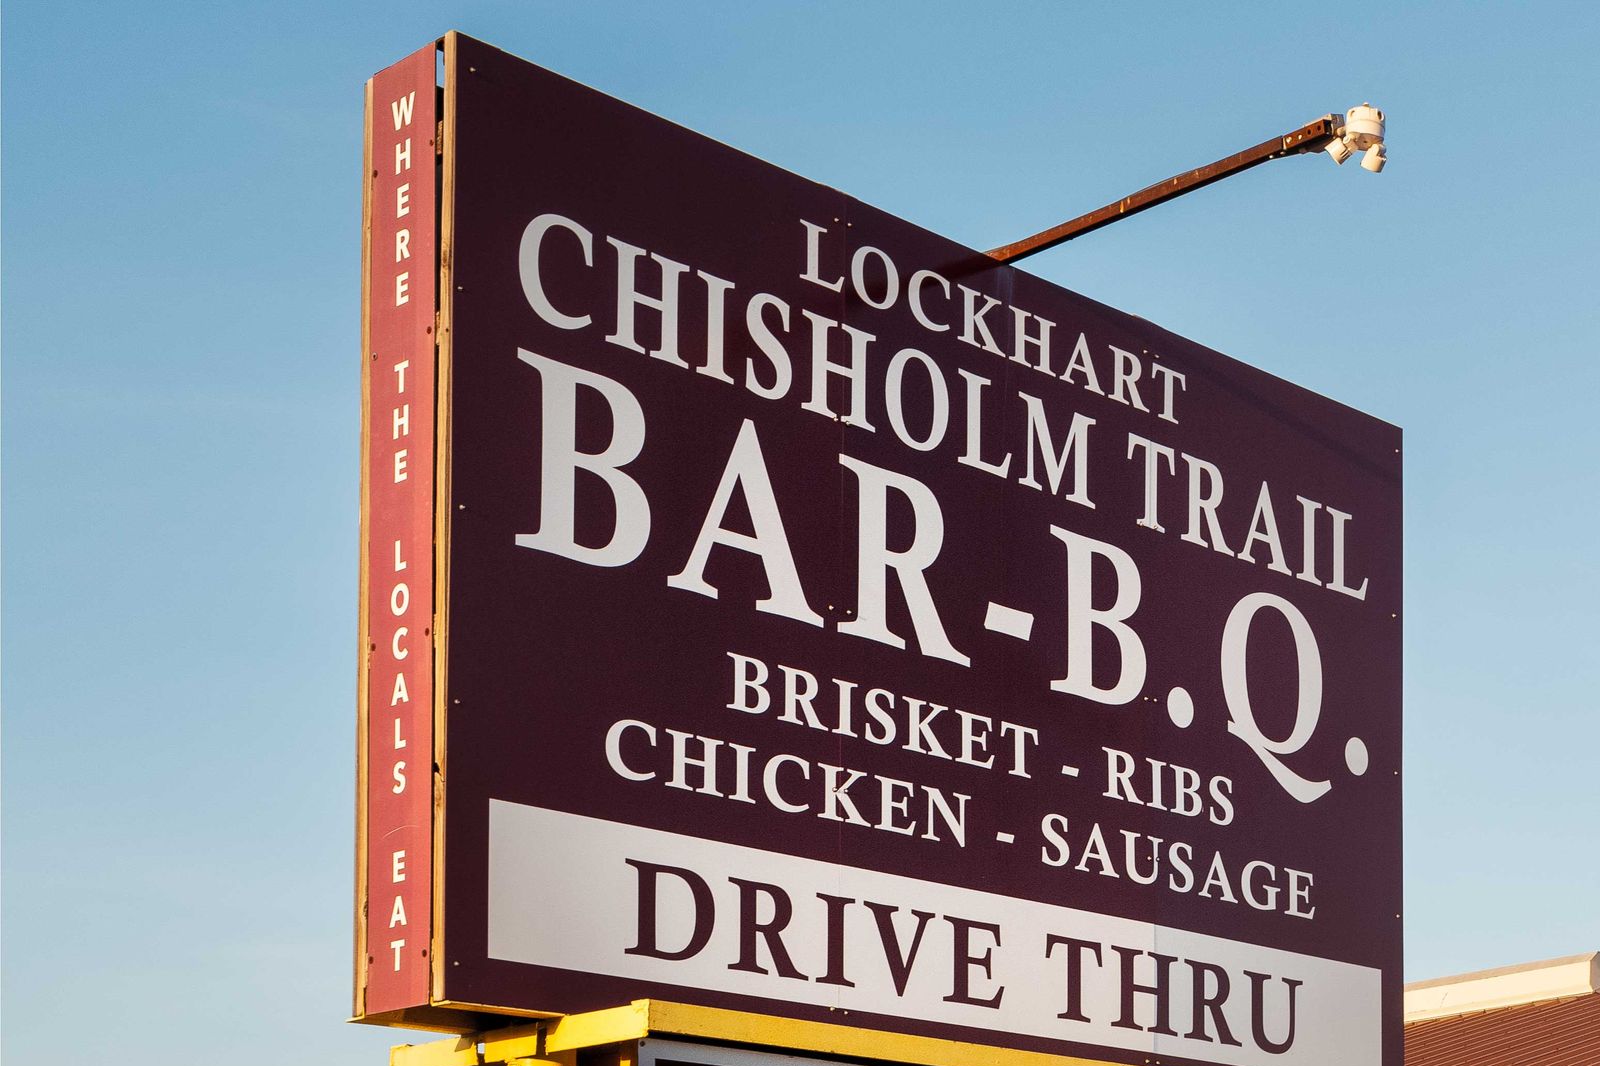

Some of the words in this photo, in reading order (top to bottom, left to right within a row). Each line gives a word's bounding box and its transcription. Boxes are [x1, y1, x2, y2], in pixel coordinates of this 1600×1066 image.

[391, 91, 416, 307] WHERE
[392, 360, 410, 484] THE
[519, 213, 1097, 510] CHISHOLM
[1128, 432, 1369, 601] TRAIL
[800, 219, 1187, 425] LOCKHART
[390, 539, 410, 795] LOCALS
[727, 652, 1039, 779] BRISKET
[1102, 747, 1235, 826] RIBS
[388, 850, 409, 972] EAT
[606, 719, 972, 848] CHICKEN
[1042, 813, 1316, 920] SAUSAGE
[625, 857, 1005, 1010] DRIVE
[1045, 933, 1304, 1055] THRU
